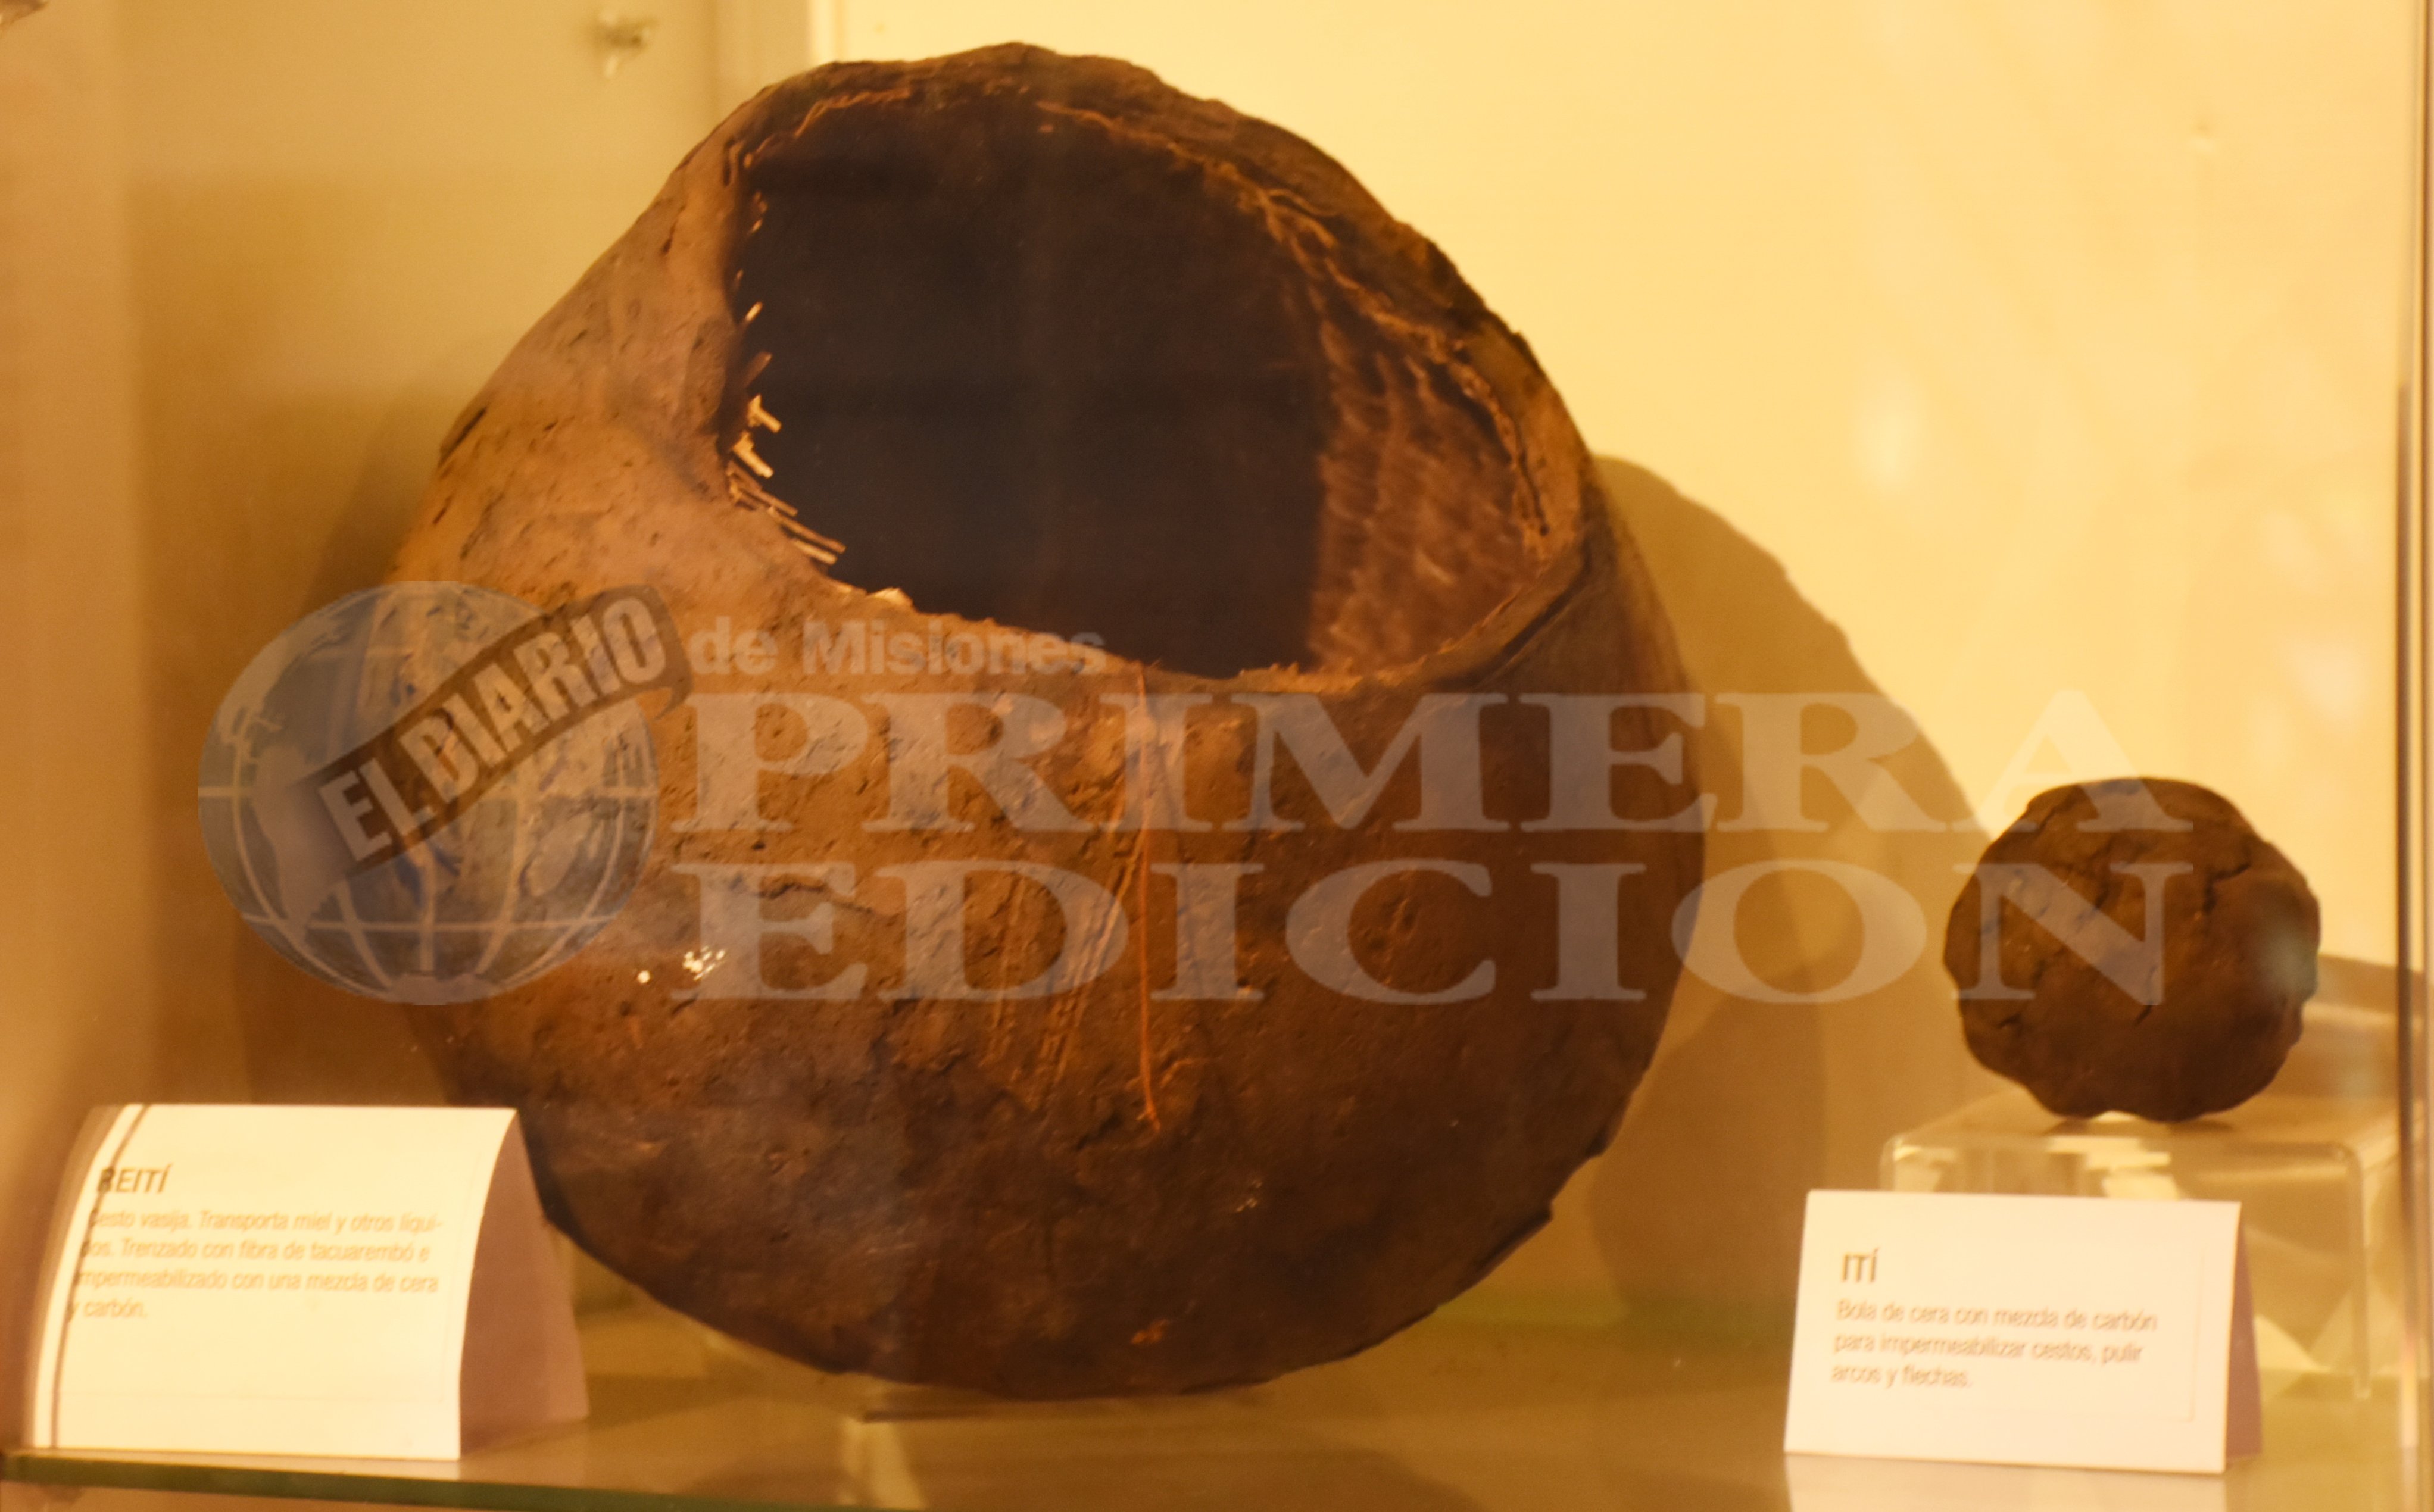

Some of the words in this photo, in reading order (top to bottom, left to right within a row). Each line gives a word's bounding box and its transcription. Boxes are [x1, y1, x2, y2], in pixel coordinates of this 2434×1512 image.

[97, 1162, 174, 1194] REITÍ
[199, 1210, 289, 1232] Transporta
[293, 1211, 333, 1231] miel
[335, 1216, 348, 1235] y
[350, 1213, 395, 1232] otros
[121, 1236, 198, 1258] Trenzado
[202, 1242, 234, 1258] con
[238, 1238, 279, 1261] fibra
[283, 1241, 306, 1261] de
[310, 1241, 415, 1263] tacuarembó
[418, 1245, 431, 1263] e
[1842, 1247, 1880, 1283] ITÍ
[231, 1272, 264, 1291] con
[269, 1273, 301, 1291] una
[305, 1273, 369, 1291] mezcla
[372, 1273, 395, 1292] de
[400, 1276, 440, 1294] cera
[83, 1297, 148, 1318] carbón.
[1836, 1298, 1876, 1321] Bola
[1883, 1301, 1905, 1322] de
[1909, 1306, 1949, 1324] cera
[1954, 1307, 1989, 1325] con
[1992, 1306, 2058, 1328] mezcla
[2064, 1308, 2087, 1329] de
[2092, 1308, 2158, 1332] carbón
[1833, 1333, 1875, 1355] para
[1880, 1331, 2027, 1358] impermeabilizar
[2032, 1339, 2097, 1364] cestos,
[2101, 1341, 2145, 1367] pulir
[1831, 1365, 1881, 1383] arcos
[1886, 1369, 1899, 1389] y
[1902, 1364, 1973, 1388] flechas.
